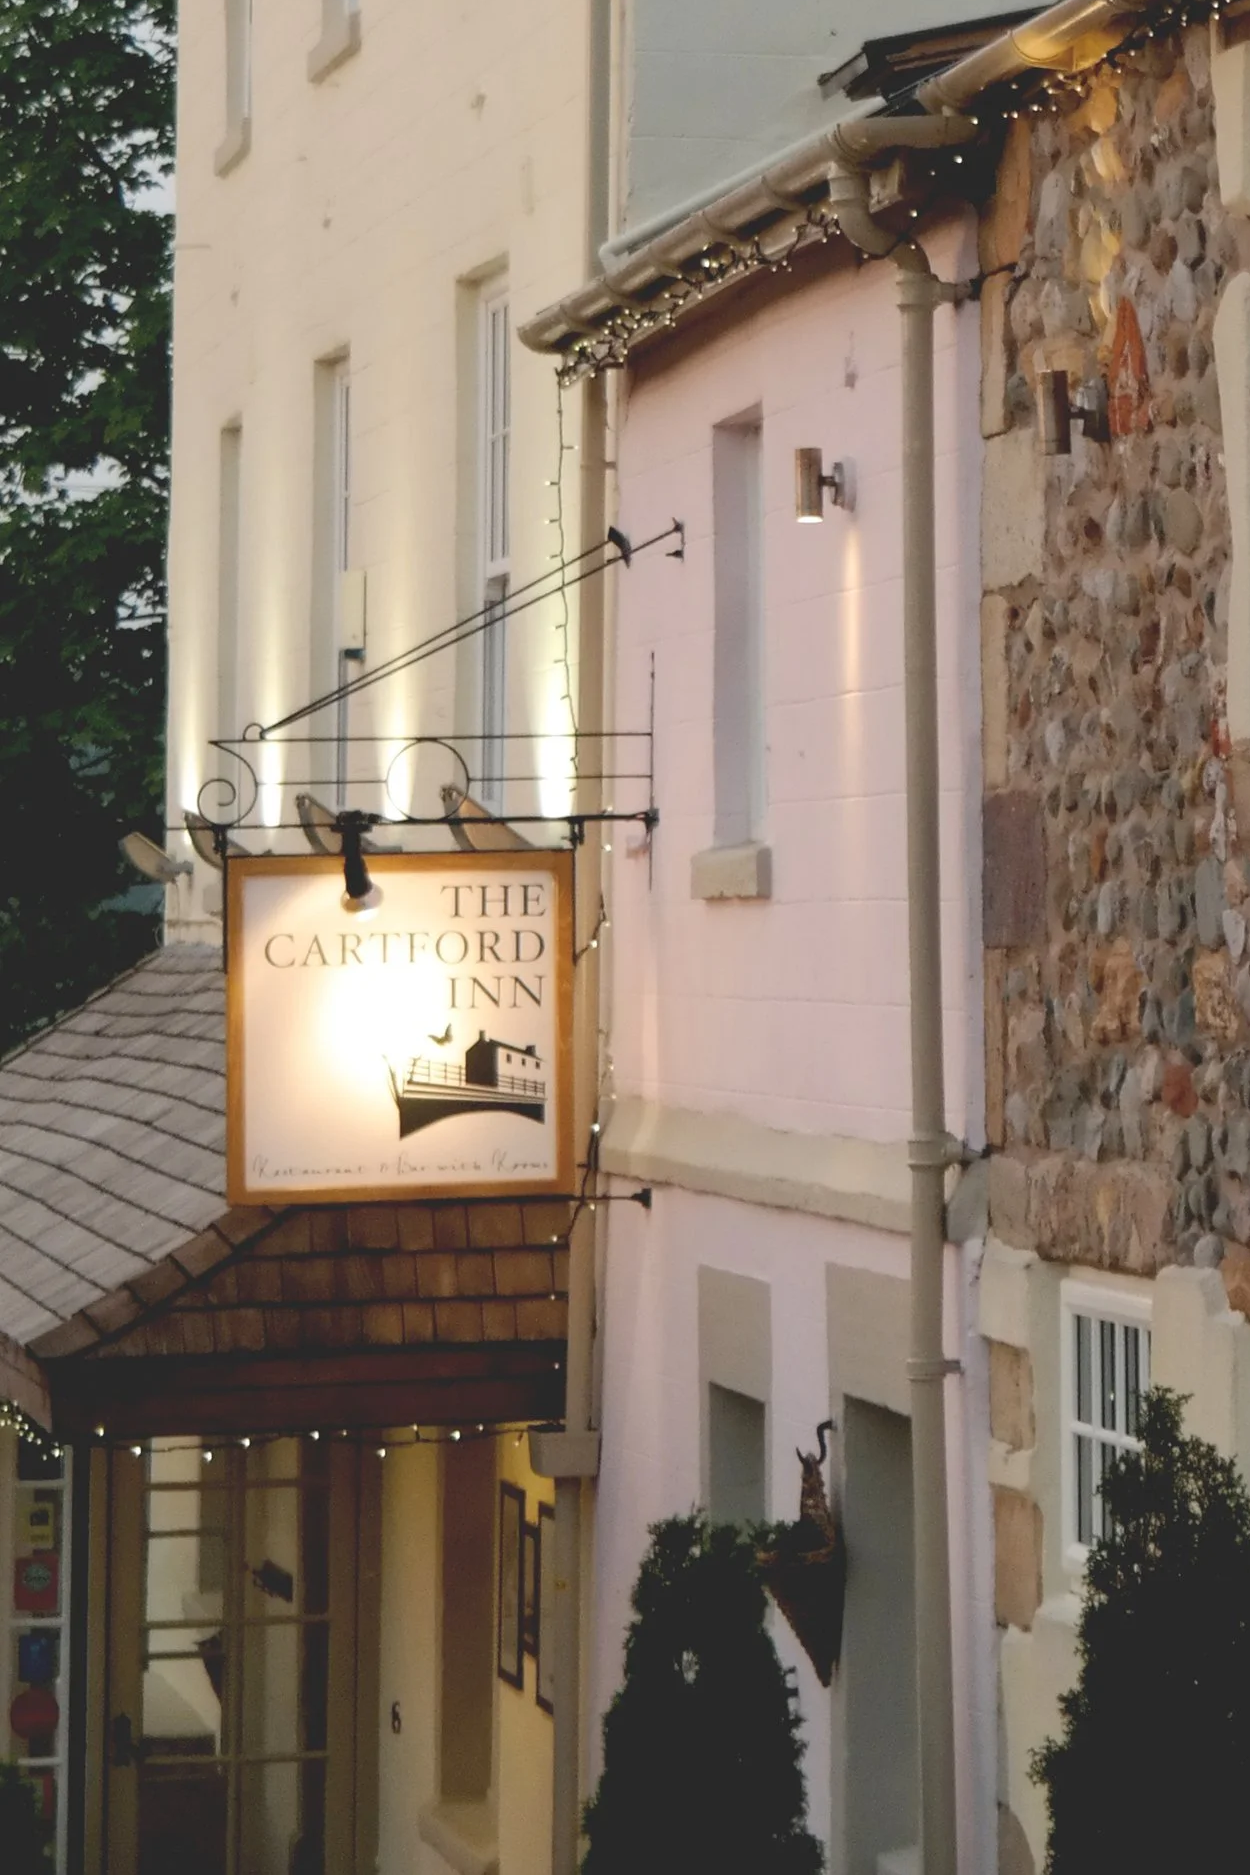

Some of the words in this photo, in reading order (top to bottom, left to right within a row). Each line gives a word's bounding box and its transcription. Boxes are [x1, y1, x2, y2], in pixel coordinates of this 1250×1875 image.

[440, 883, 546, 918] THE
[264, 929, 546, 968] CARTFORD
[449, 975, 544, 1009] INN
